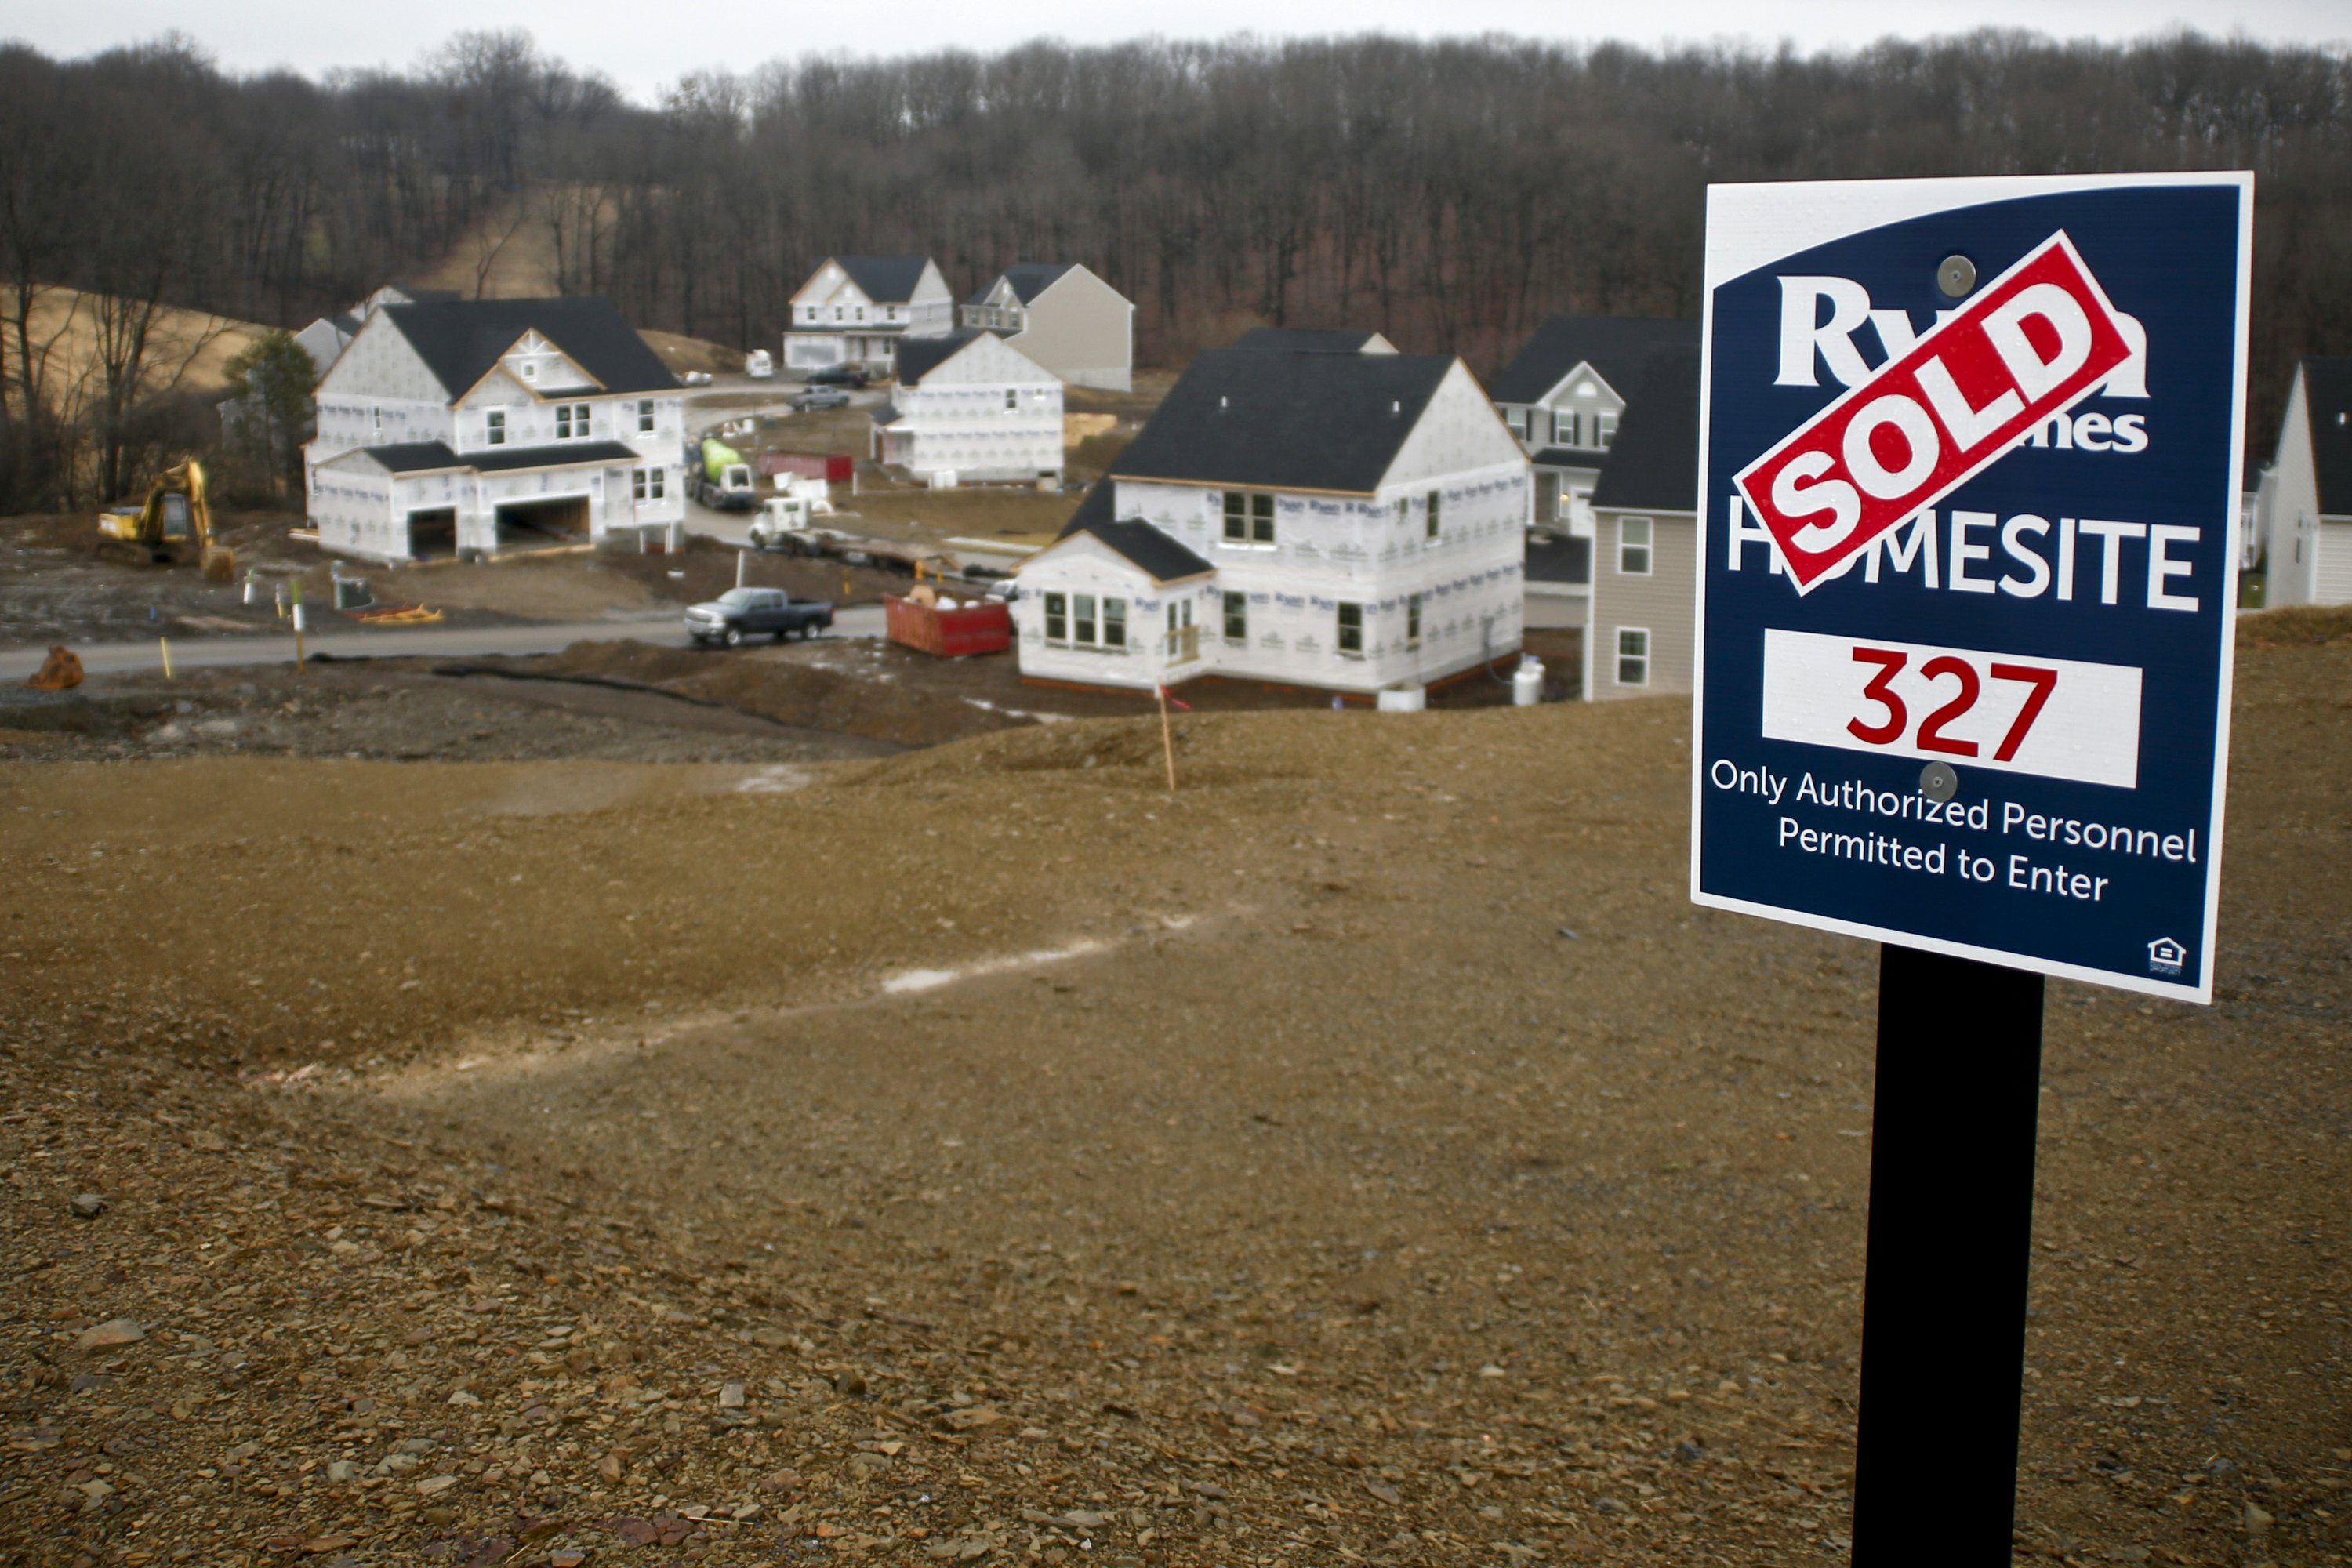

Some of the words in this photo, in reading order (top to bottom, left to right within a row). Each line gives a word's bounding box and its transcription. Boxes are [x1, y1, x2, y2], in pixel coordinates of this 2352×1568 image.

[1771, 283, 2092, 554] SOLD
[1728, 495, 2201, 612] HMESITE
[1846, 647, 2057, 762] 327
[1711, 759, 1788, 805] Only
[1796, 772, 1989, 830] Authorized
[2003, 801, 2196, 863] Personnel
[1780, 816, 1946, 874] Permitted
[1958, 849, 1995, 882] to
[2009, 855, 2109, 901] Enter
